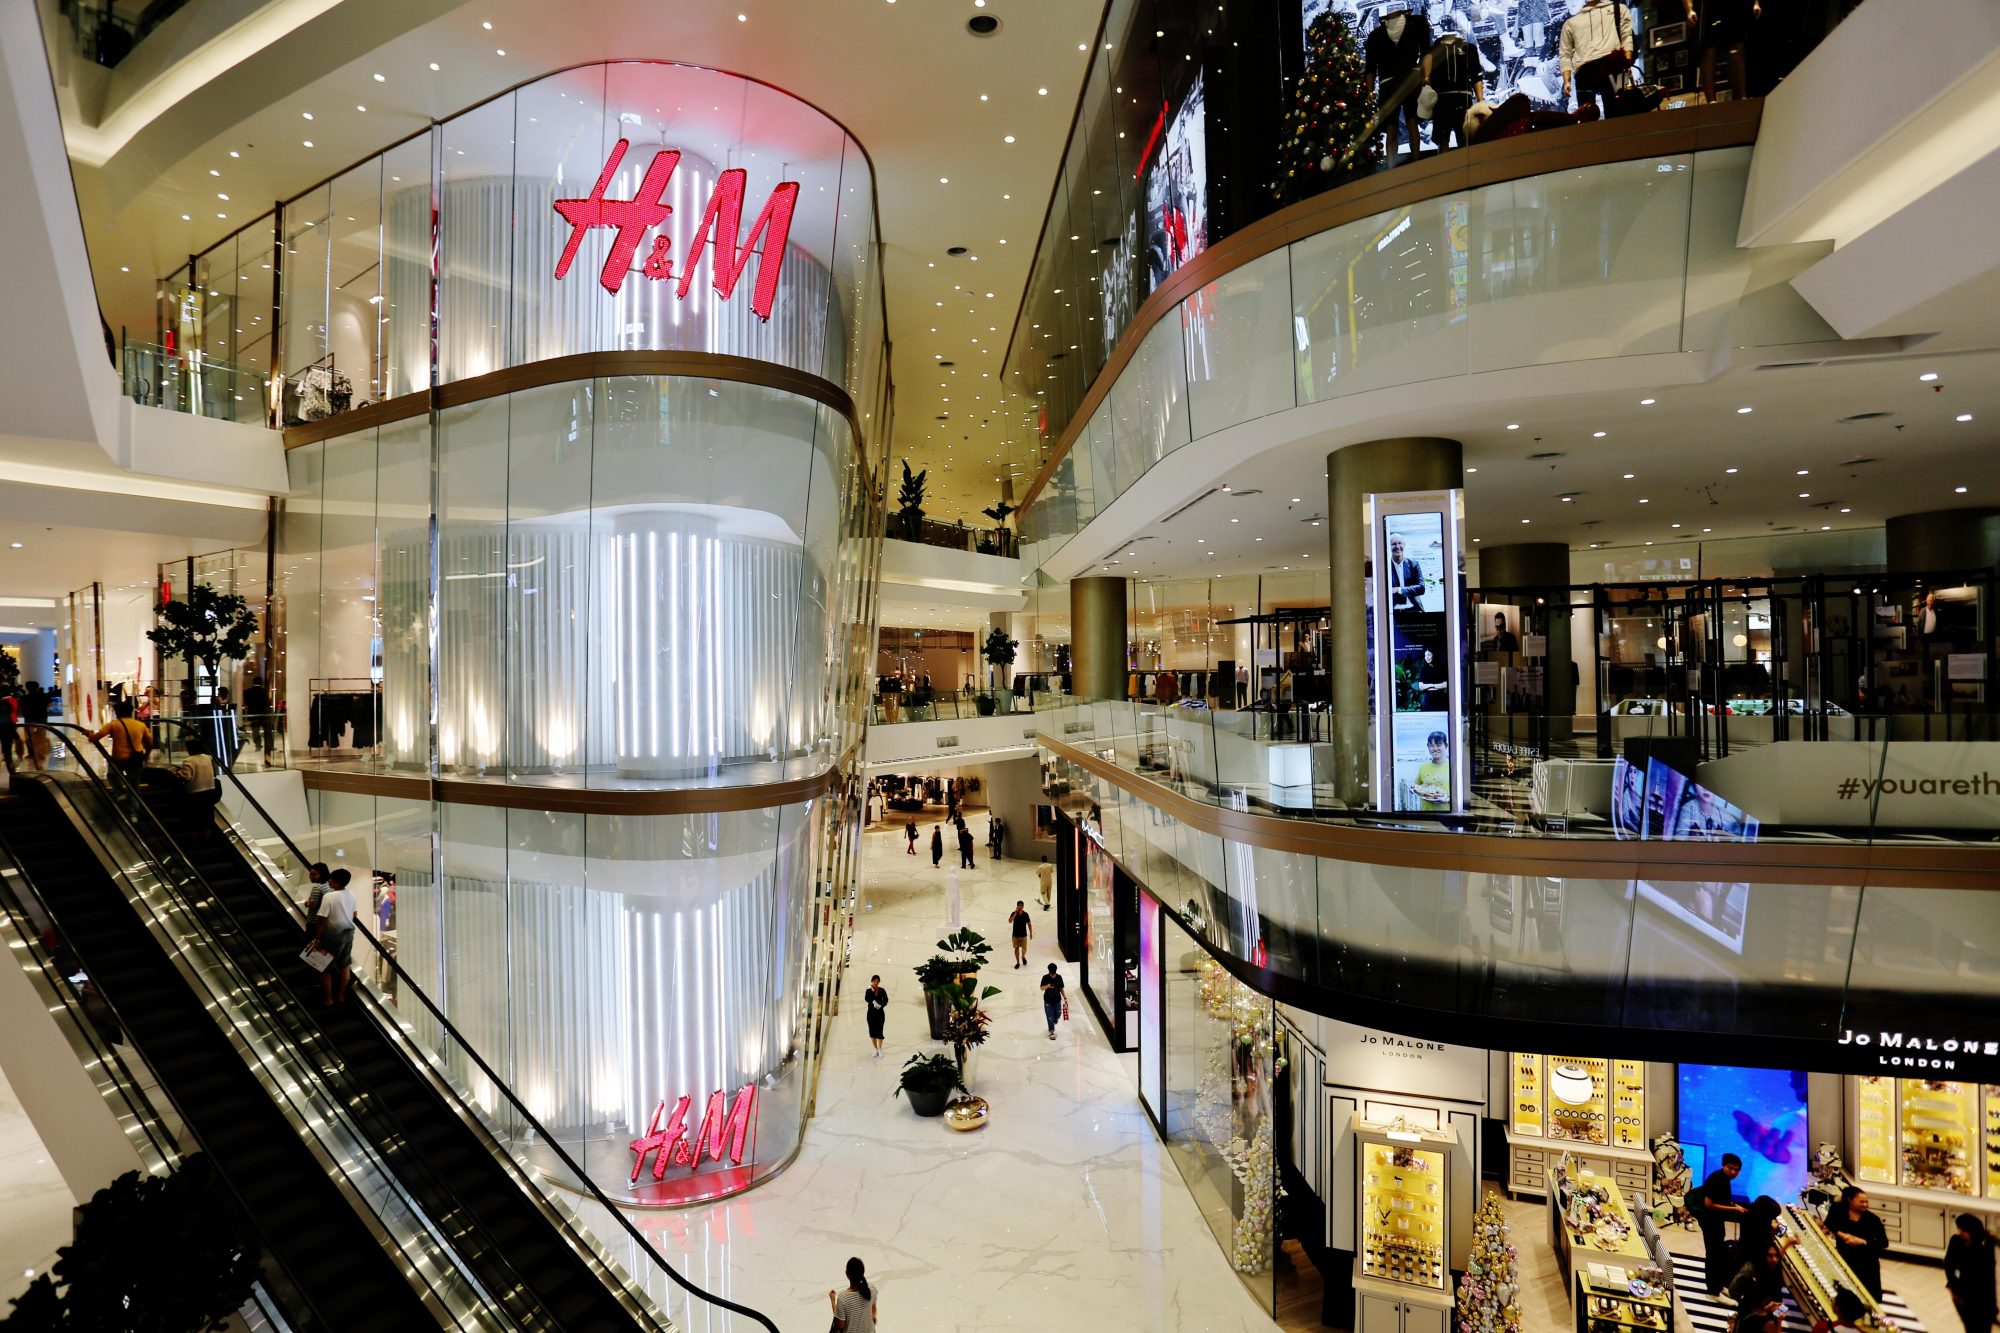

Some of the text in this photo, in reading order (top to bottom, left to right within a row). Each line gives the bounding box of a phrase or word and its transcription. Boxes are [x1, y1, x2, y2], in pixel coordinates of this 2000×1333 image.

[553, 138, 800, 323] H&M
[1837, 771, 2000, 800] #youareth
[1382, 1036, 1446, 1051] MALONE
[1382, 1050, 1423, 1060] LONDON
[1879, 1032, 1999, 1056] MALONE
[1879, 1055, 1955, 1070] LONDON
[629, 1082, 755, 1184] H&M
